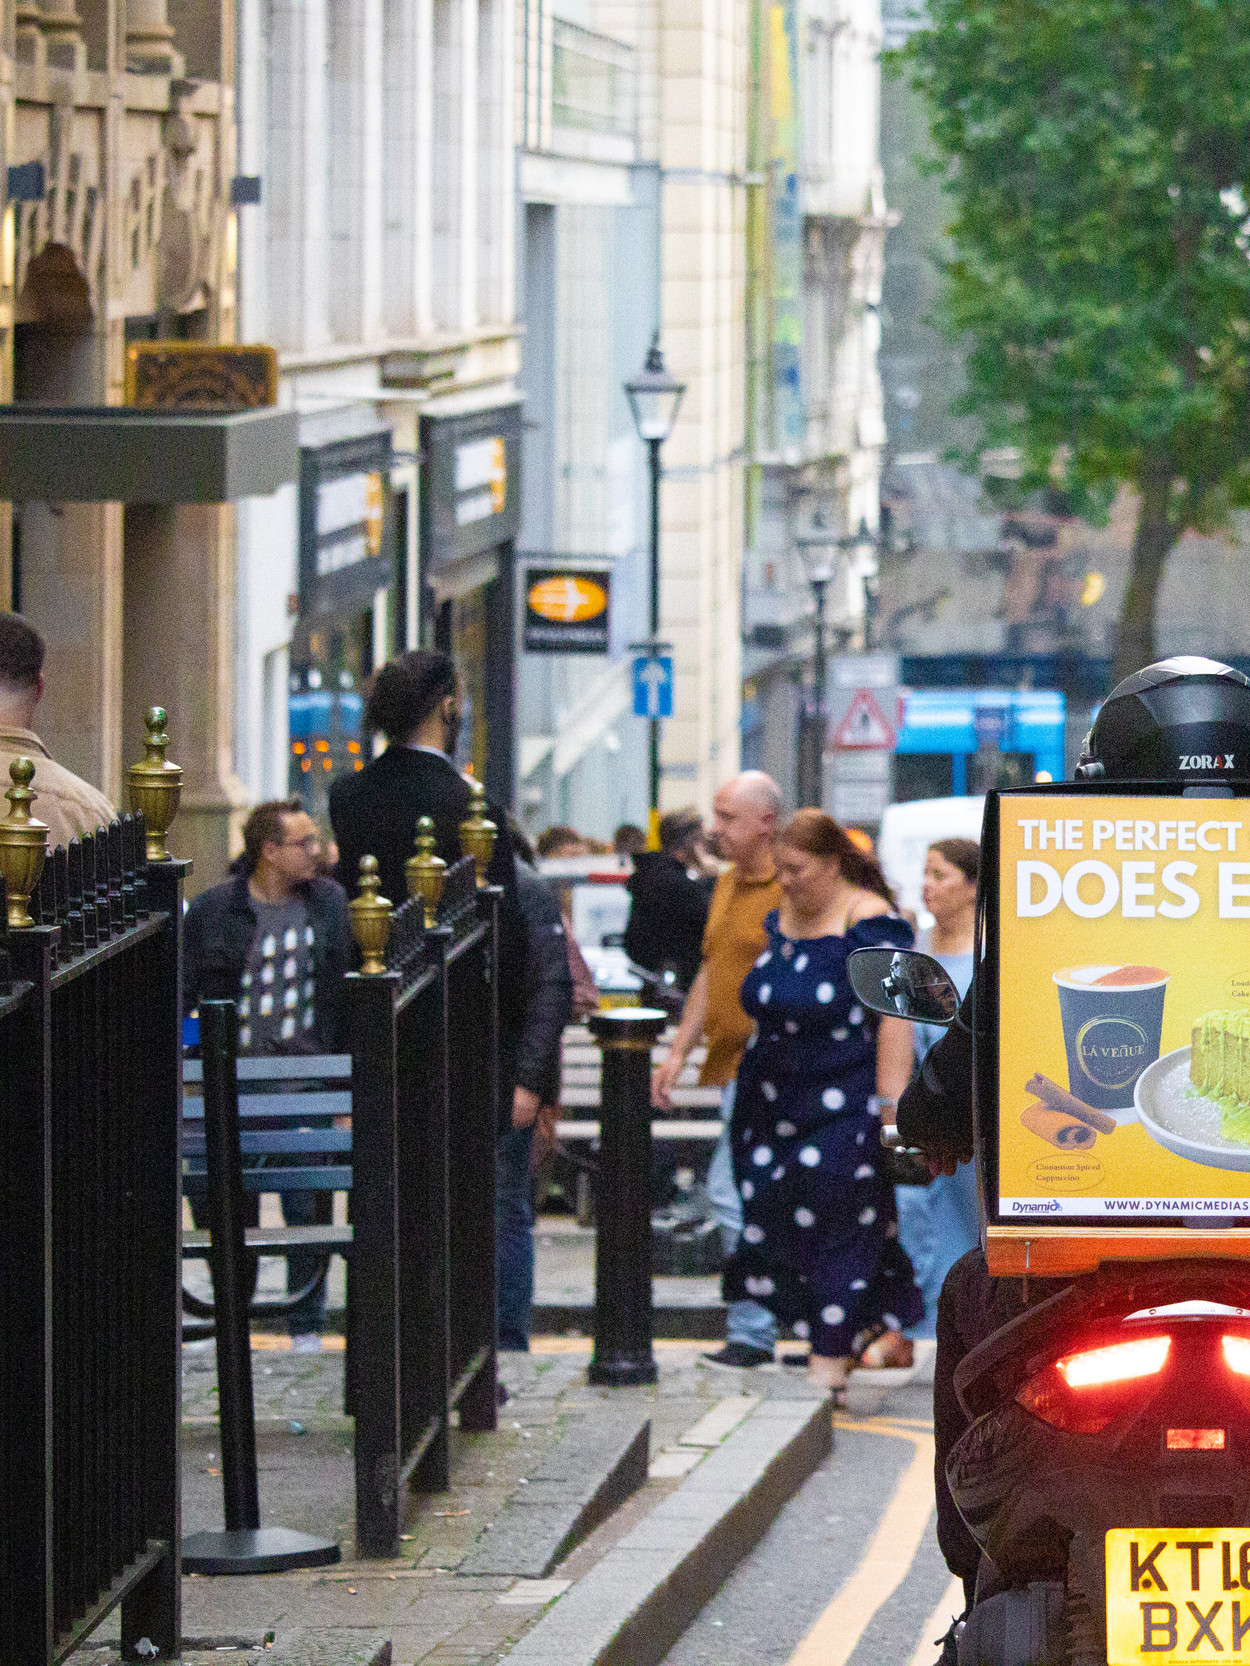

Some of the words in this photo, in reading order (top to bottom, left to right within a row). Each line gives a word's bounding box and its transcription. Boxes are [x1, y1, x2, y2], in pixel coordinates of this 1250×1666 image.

[1179, 754, 1235, 770] ZORAX
[1017, 819, 1083, 850] THE
[1092, 820, 1242, 851] PERFECT
[1016, 860, 1200, 919] DOES
[1036, 1163, 1075, 1171] Cinnamon
[1076, 1163, 1101, 1171] Spiced
[1012, 1201, 1059, 1213] Dynamic
